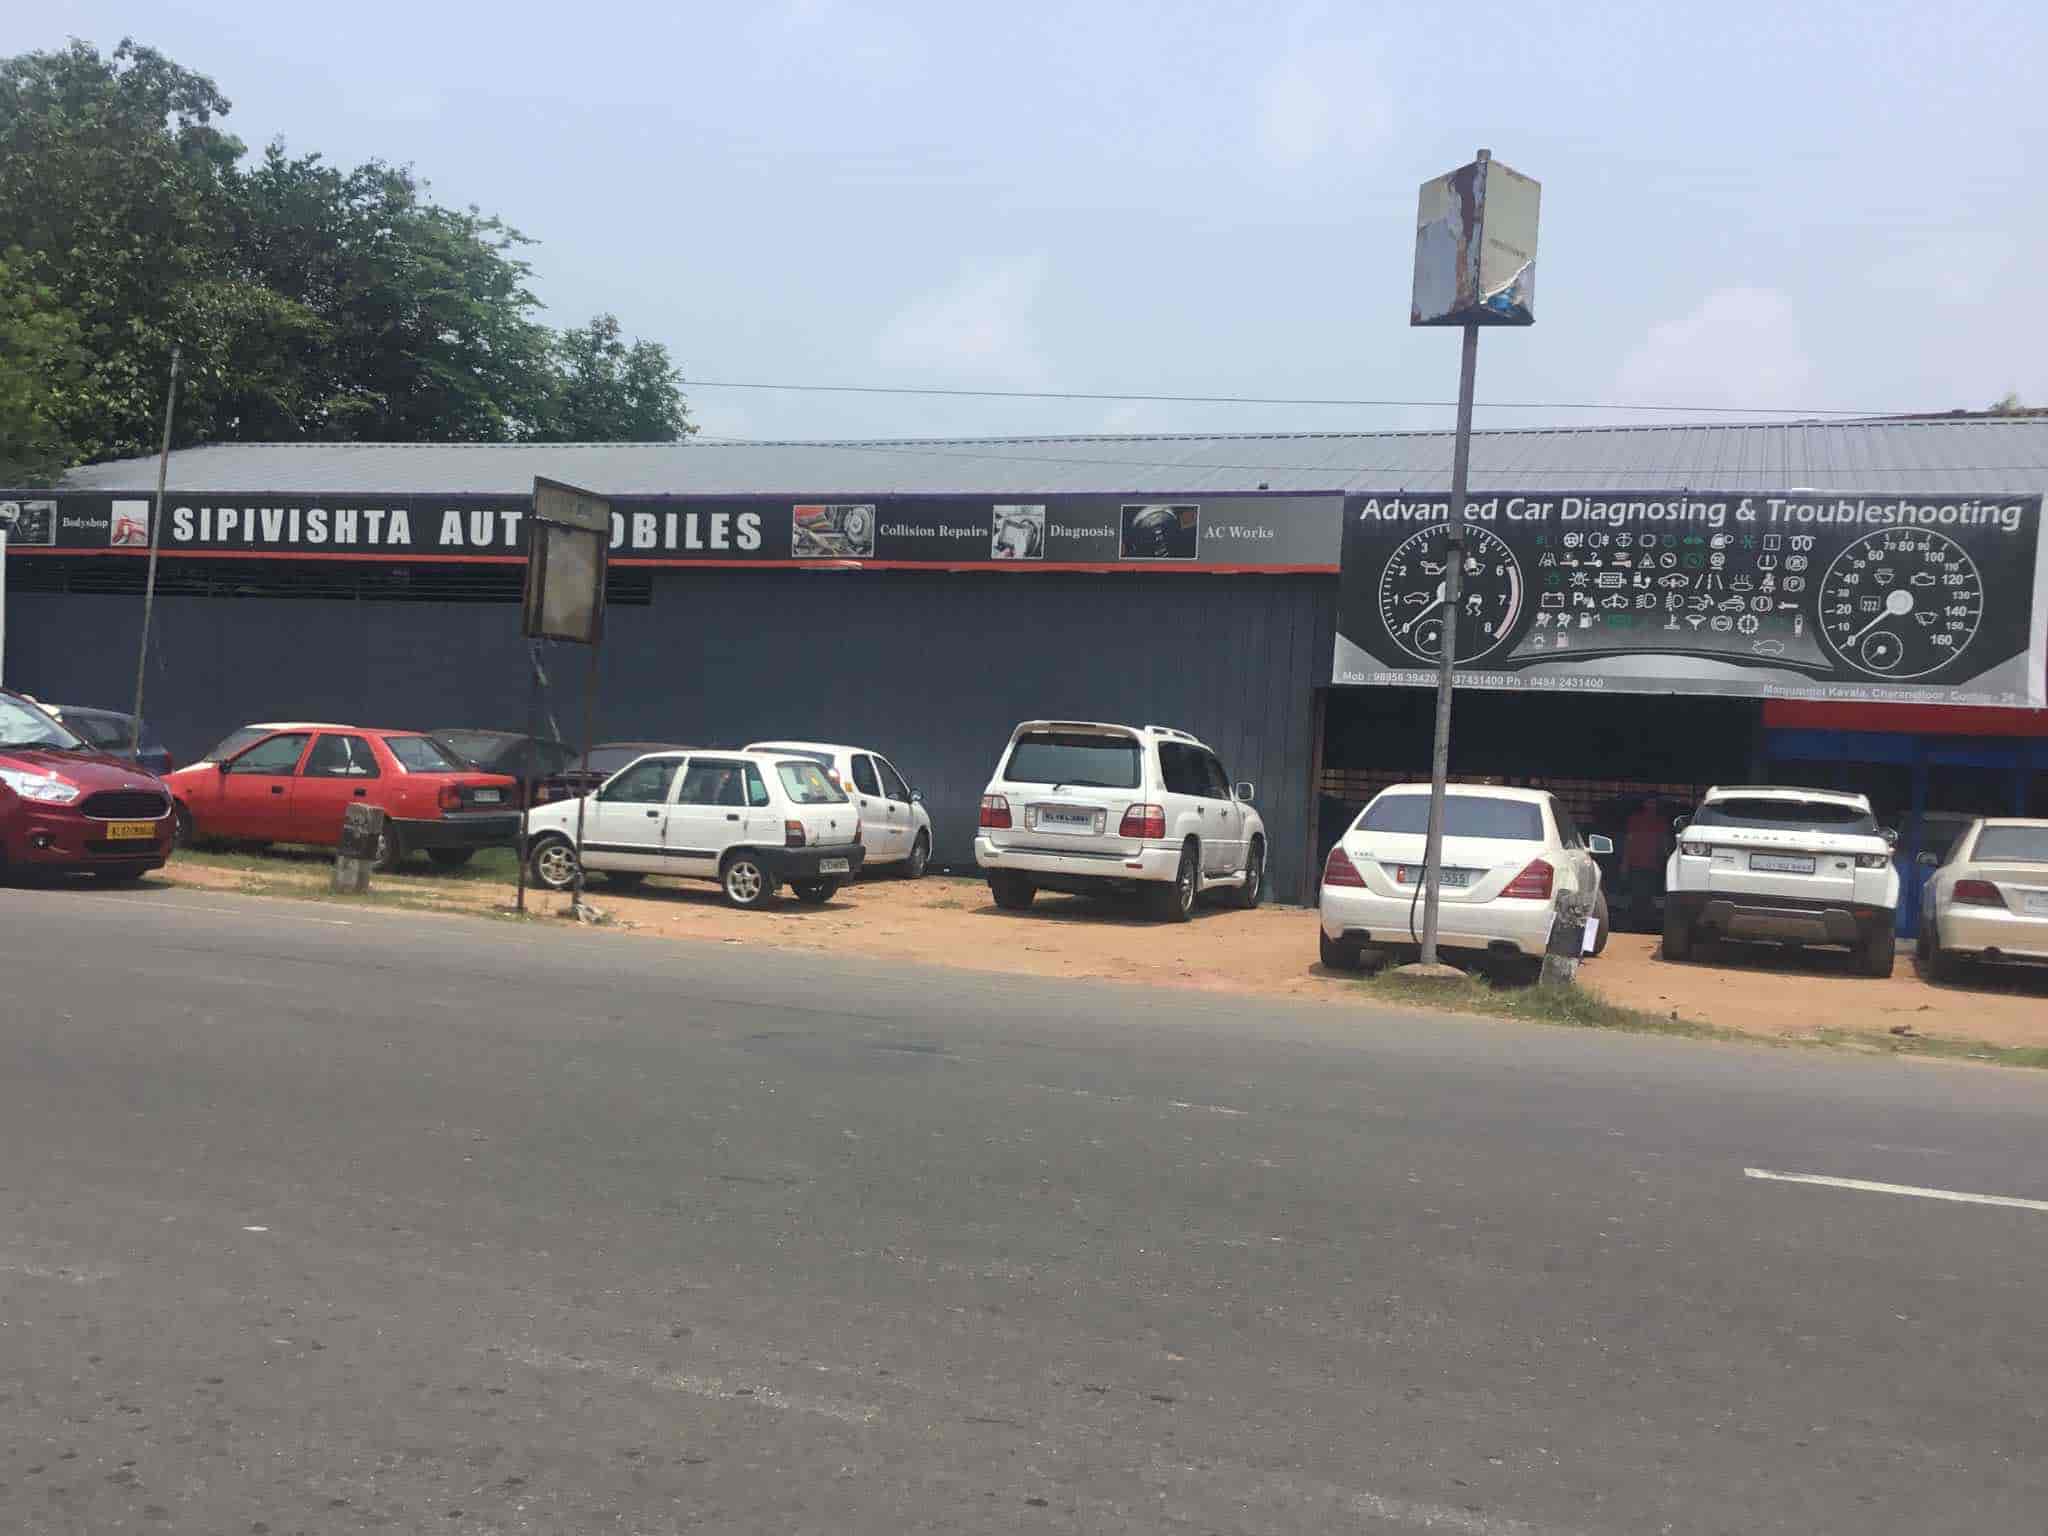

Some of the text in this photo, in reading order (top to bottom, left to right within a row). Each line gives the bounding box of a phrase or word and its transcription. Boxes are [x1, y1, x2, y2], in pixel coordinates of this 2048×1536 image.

[1359, 498, 2022, 531] Advaned Car Diagnosing & Troubleshooting
[173, 507, 762, 550] SIPIVISHTA AUTOBILES
[880, 524, 988, 540] Collision Repairs
[1050, 524, 1115, 539] Diagnosis
[1205, 526, 1275, 539] AC Works
[1420, 543, 1429, 553] 3
[1478, 543, 1487, 553] 5
[1898, 541, 1915, 552] 80
[1867, 549, 1884, 561] 60
[1925, 551, 1945, 562] 100
[1853, 560, 1866, 569] 50
[1398, 566, 1407, 576] 2
[1496, 566, 1504, 576] 6
[1843, 573, 1860, 584] 40
[1942, 574, 1964, 585] 120
[1498, 595, 1506, 605] 7
[1836, 603, 1852, 614] 20
[1944, 606, 1967, 617] 140
[1484, 622, 1492, 632] 8
[1838, 622, 1850, 631] 10
[1930, 634, 1953, 646] 160
[1343, 672, 1365, 681] Mob
[1506, 676, 1521, 686] Ph
